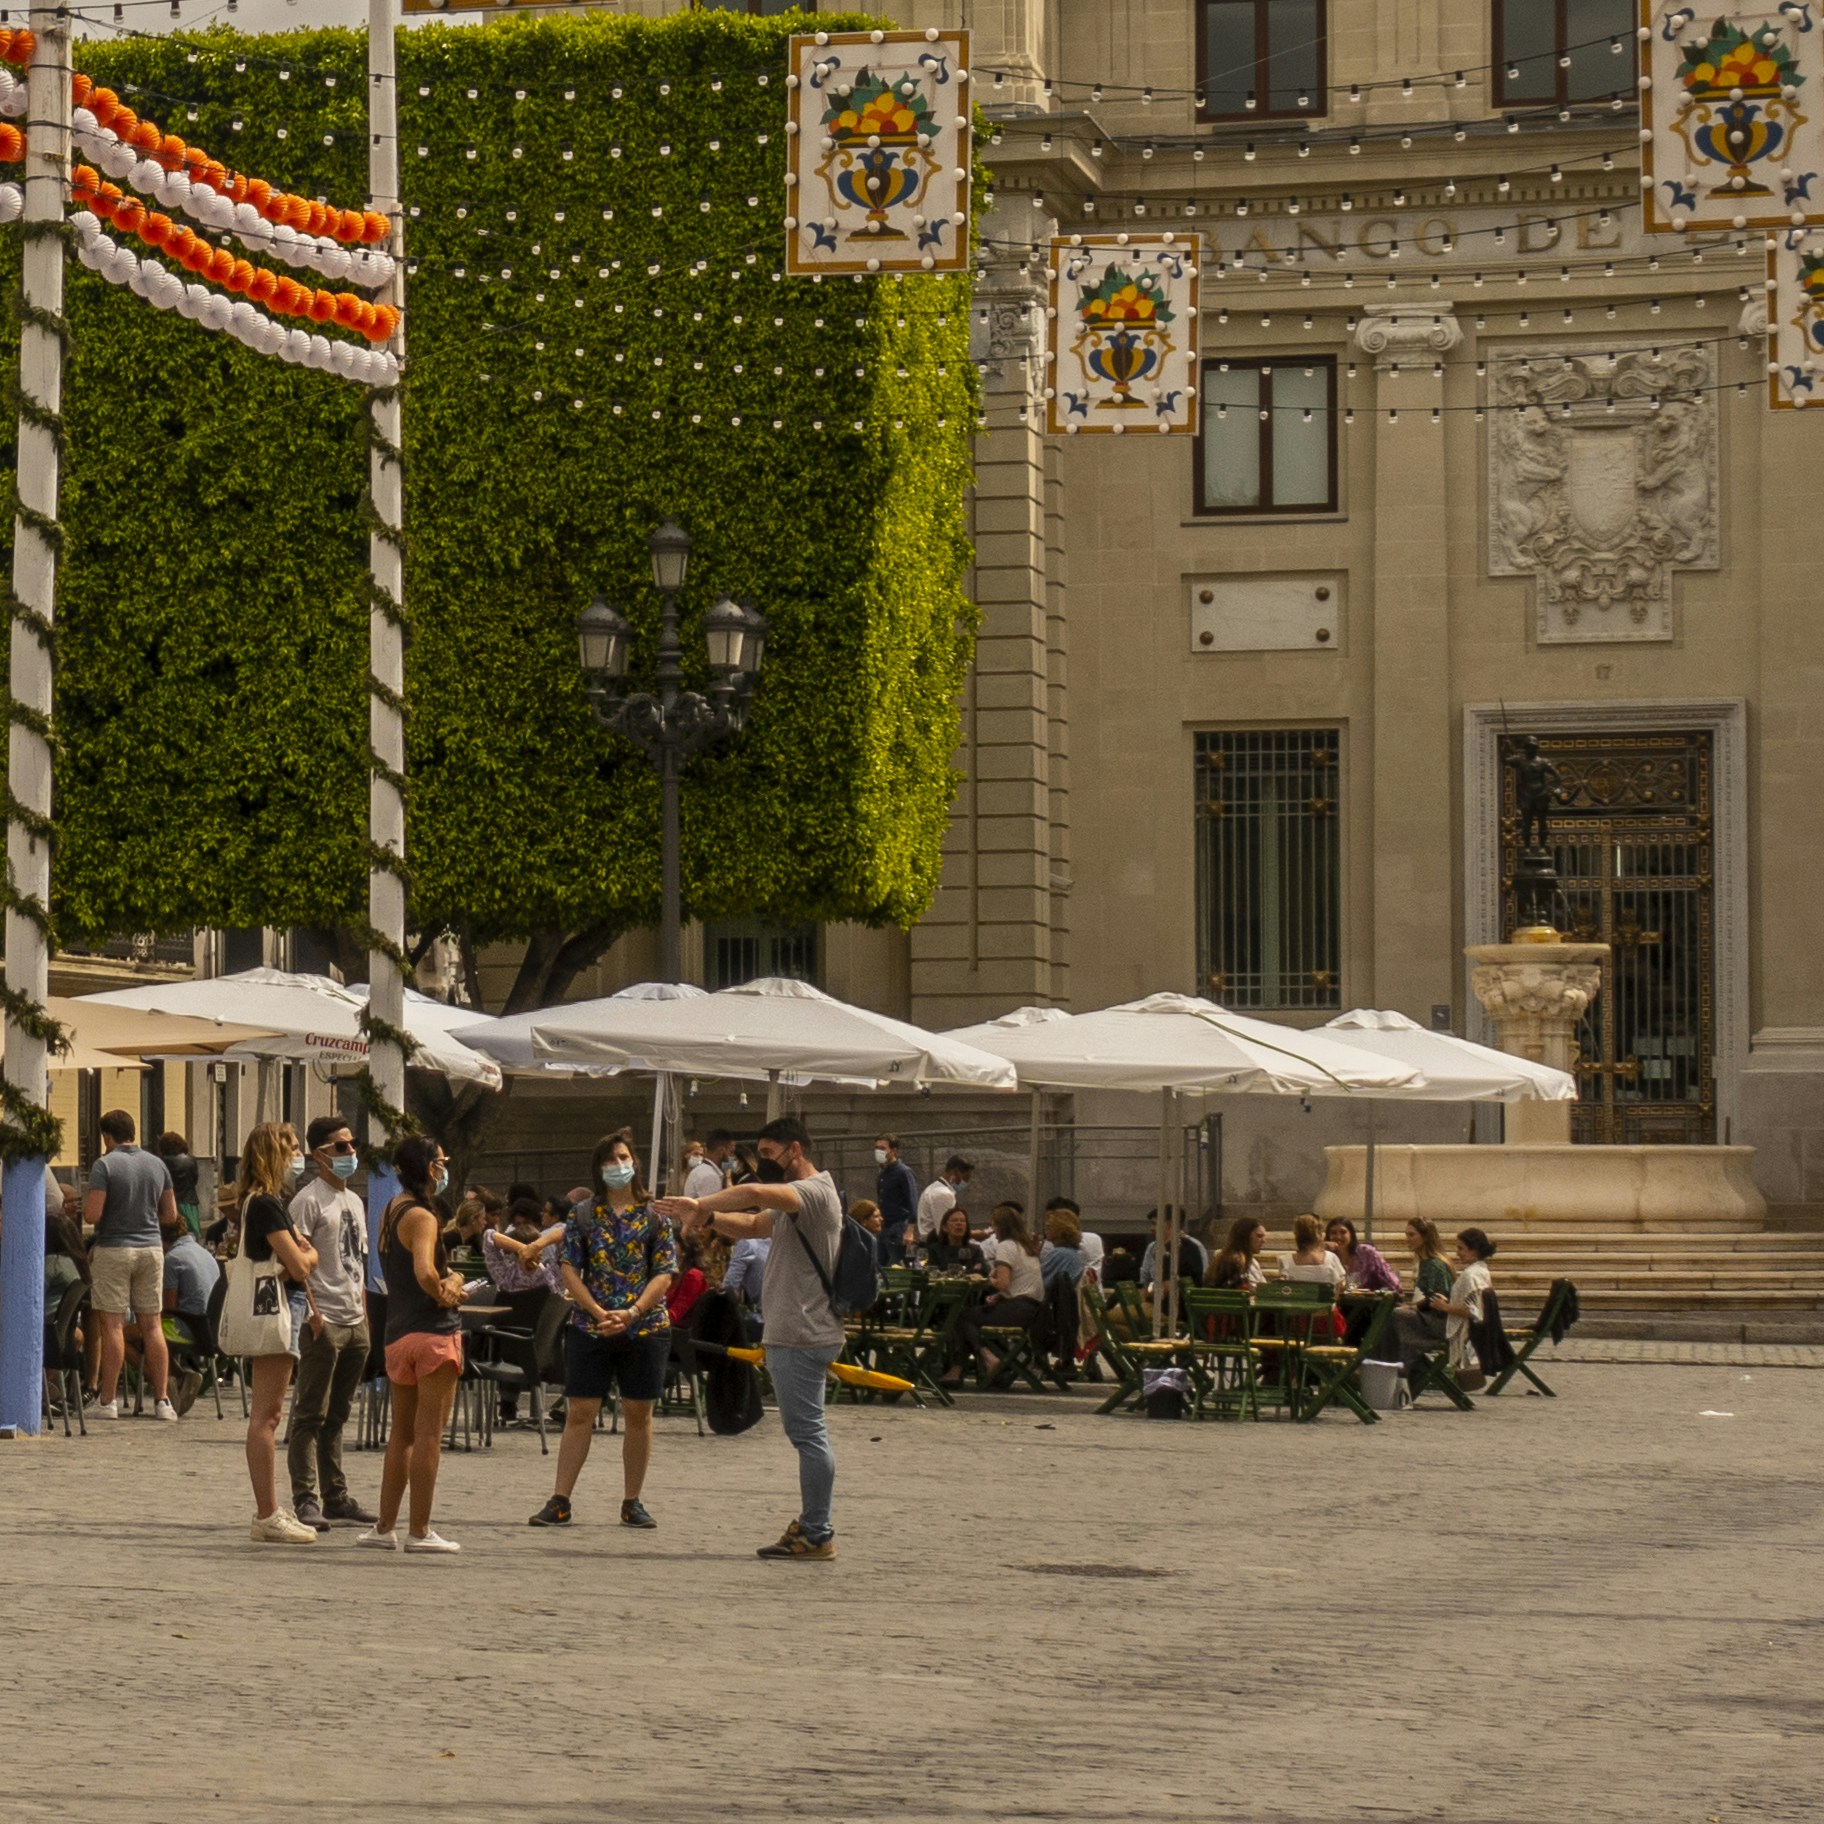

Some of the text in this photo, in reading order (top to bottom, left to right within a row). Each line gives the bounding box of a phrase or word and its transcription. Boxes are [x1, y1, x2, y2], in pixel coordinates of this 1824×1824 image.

[1198, 209, 1622, 265] BANCO DE
[305, 1032, 370, 1055] Cruzcamp
